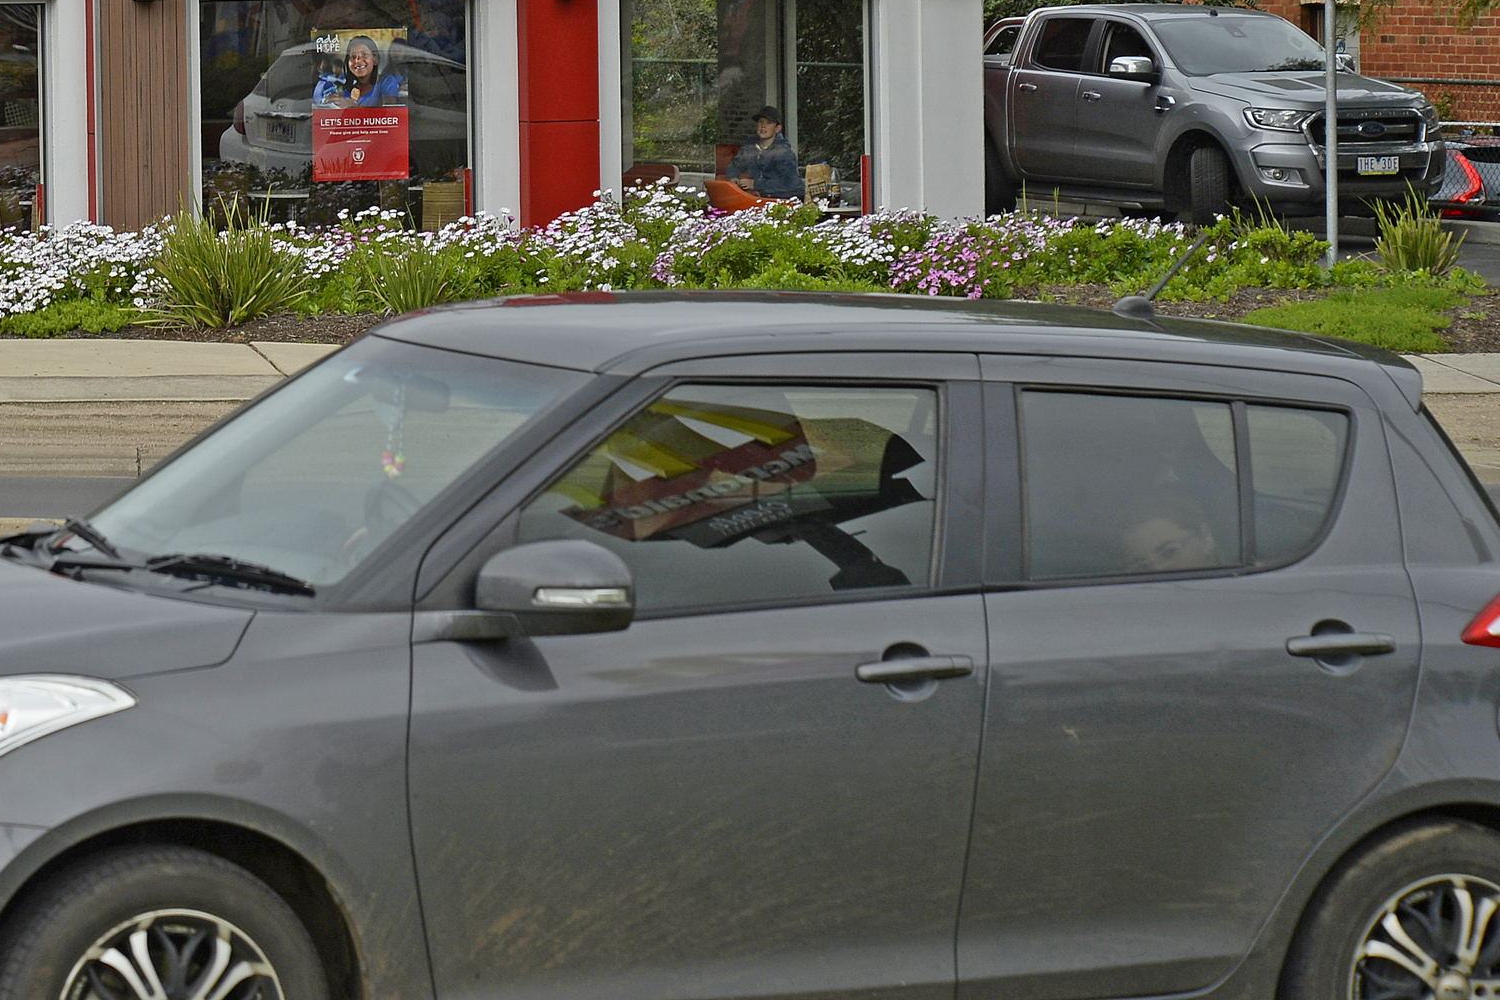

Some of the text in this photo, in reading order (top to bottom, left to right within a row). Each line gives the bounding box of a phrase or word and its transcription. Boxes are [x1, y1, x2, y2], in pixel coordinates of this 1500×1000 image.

[315, 33, 340, 44] add
[320, 117, 399, 127] LET'S END HUNGER
